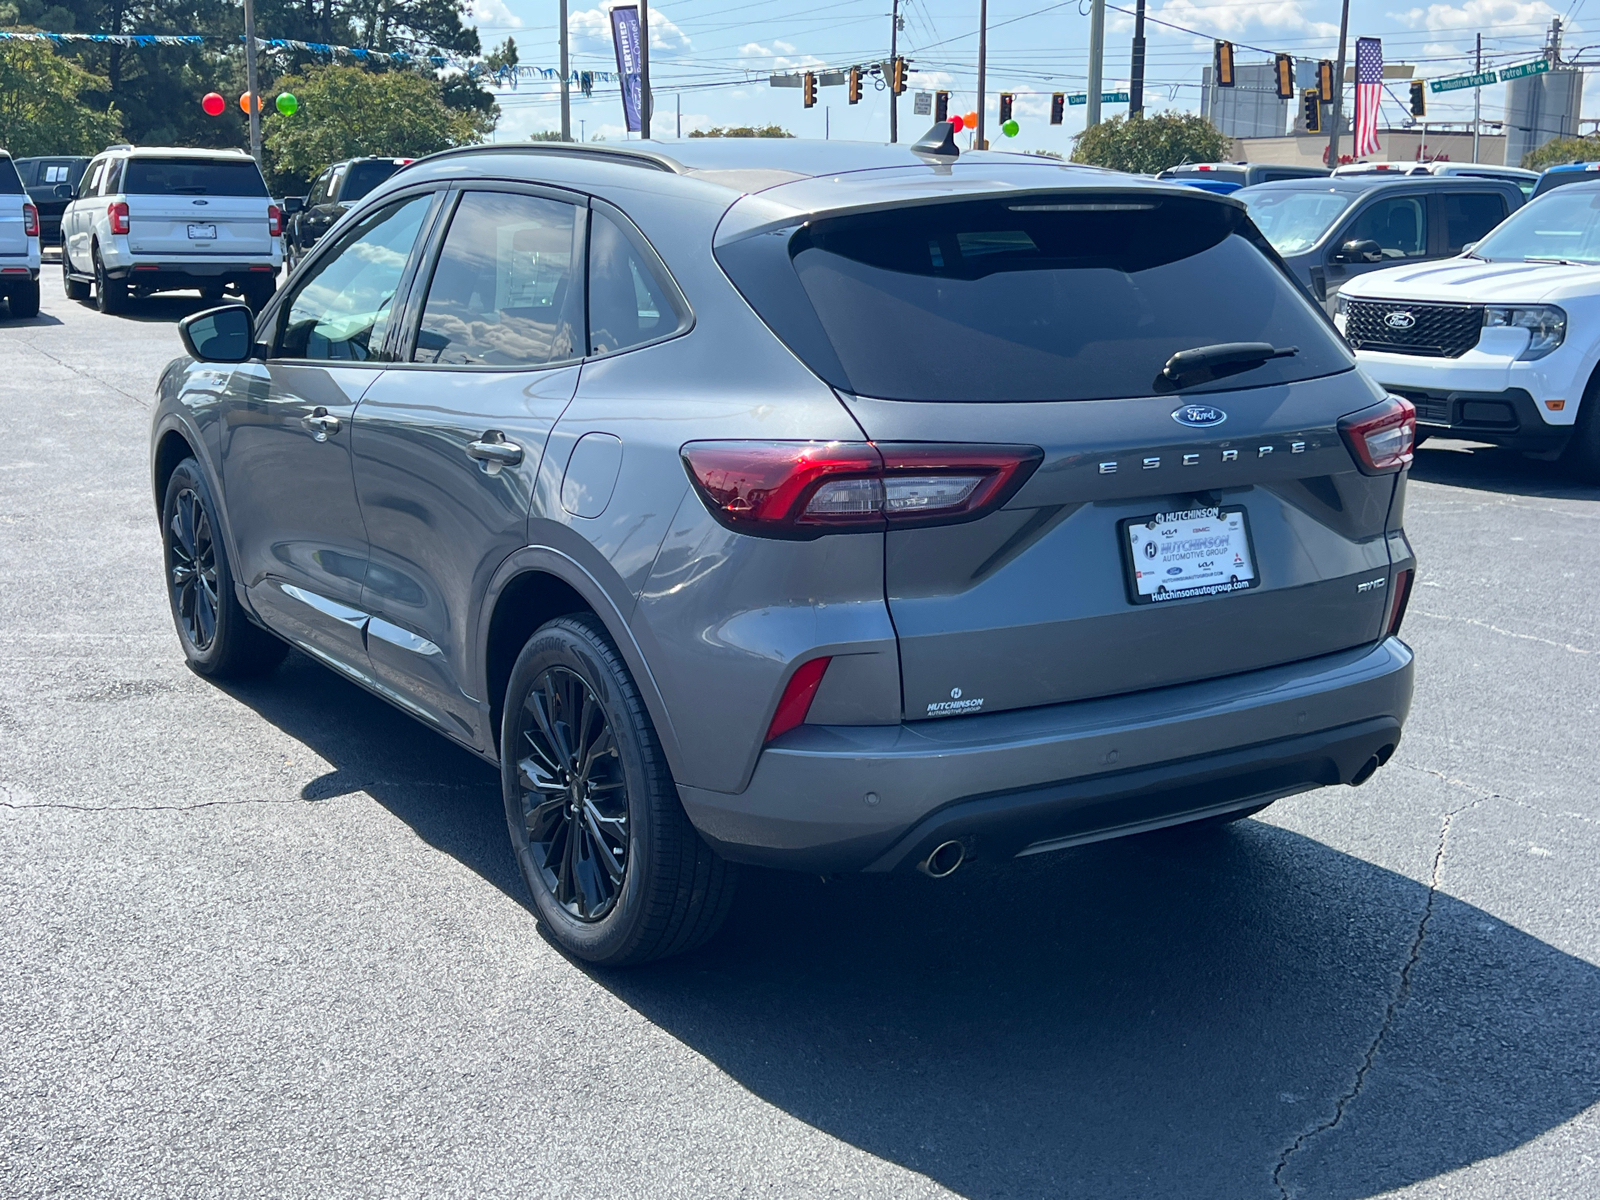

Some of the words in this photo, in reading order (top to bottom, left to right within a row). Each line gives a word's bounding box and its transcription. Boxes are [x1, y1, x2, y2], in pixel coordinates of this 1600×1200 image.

[619, 22, 633, 75] CERTIFIED
[1501, 67, 1522, 80] Patrol
[1526, 64, 1537, 74] Rd
[1441, 78, 1469, 90] Industrial
[1470, 76, 1485, 87] Park
[1485, 74, 1494, 84] Rd
[1101, 94, 1114, 102] erry
[1187, 408, 1216, 421] Ford
[1099, 442, 1305, 474] ESCAPE
[1166, 507, 1218, 522] HUTCHINSON
[1161, 535, 1229, 555] HUTCHINSON
[1163, 550, 1204, 562] AUTOMOTIVE
[1206, 547, 1228, 557] GROUP
[1152, 580, 1249, 602] Hutchinsonautogroup.com
[927, 698, 984, 711] HUTCHINSON
[928, 708, 961, 716] AUTOMOTIVE
